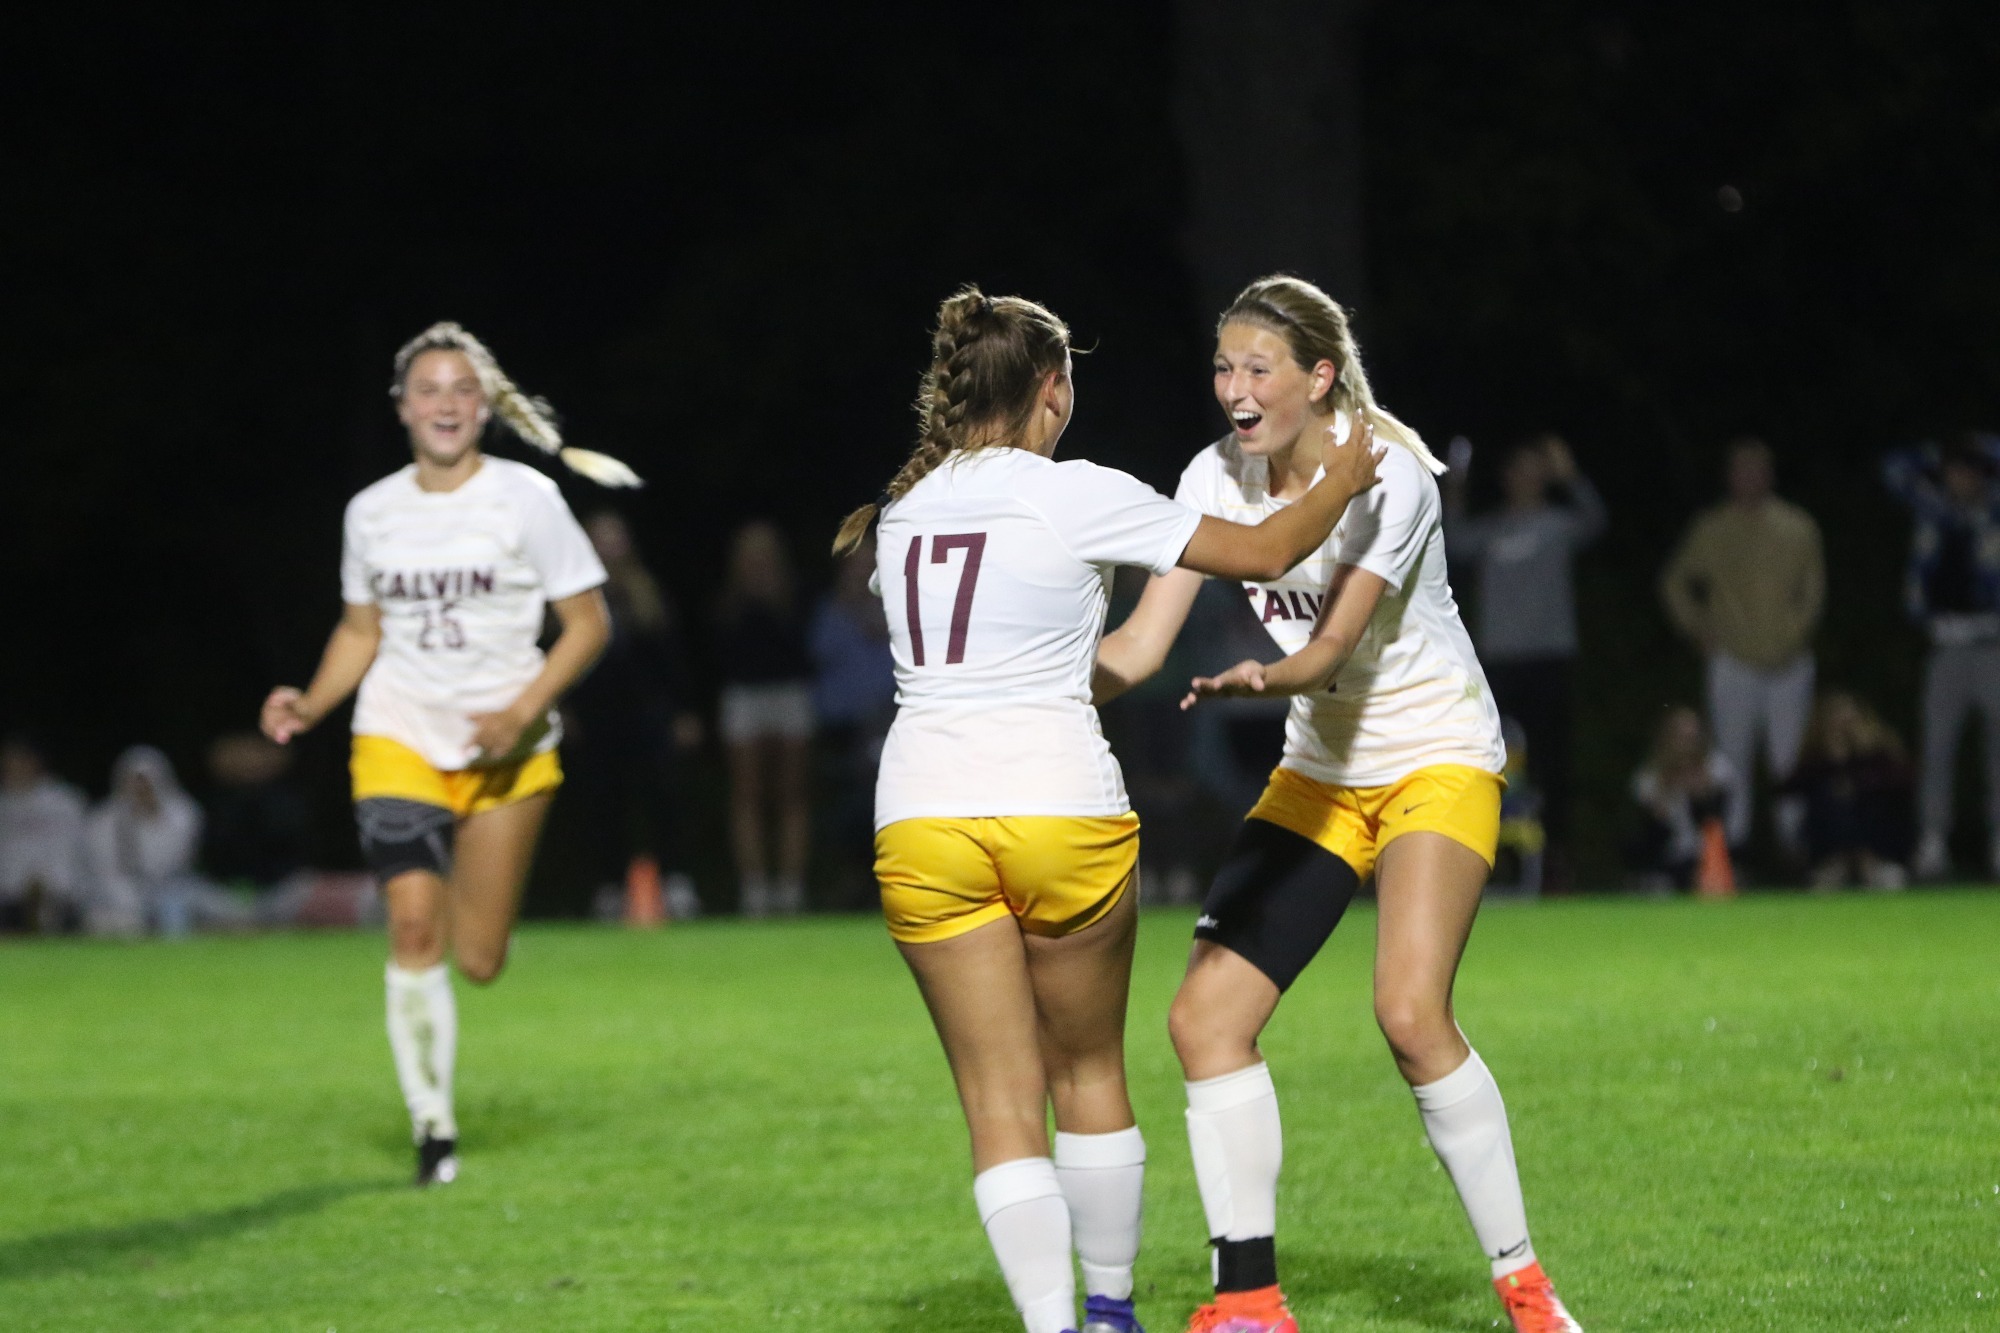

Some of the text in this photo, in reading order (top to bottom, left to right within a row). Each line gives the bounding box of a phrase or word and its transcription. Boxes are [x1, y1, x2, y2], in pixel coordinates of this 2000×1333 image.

[369, 568, 494, 600] CALVIN
[904, 532, 987, 666] 17
[416, 602, 465, 648] 25
